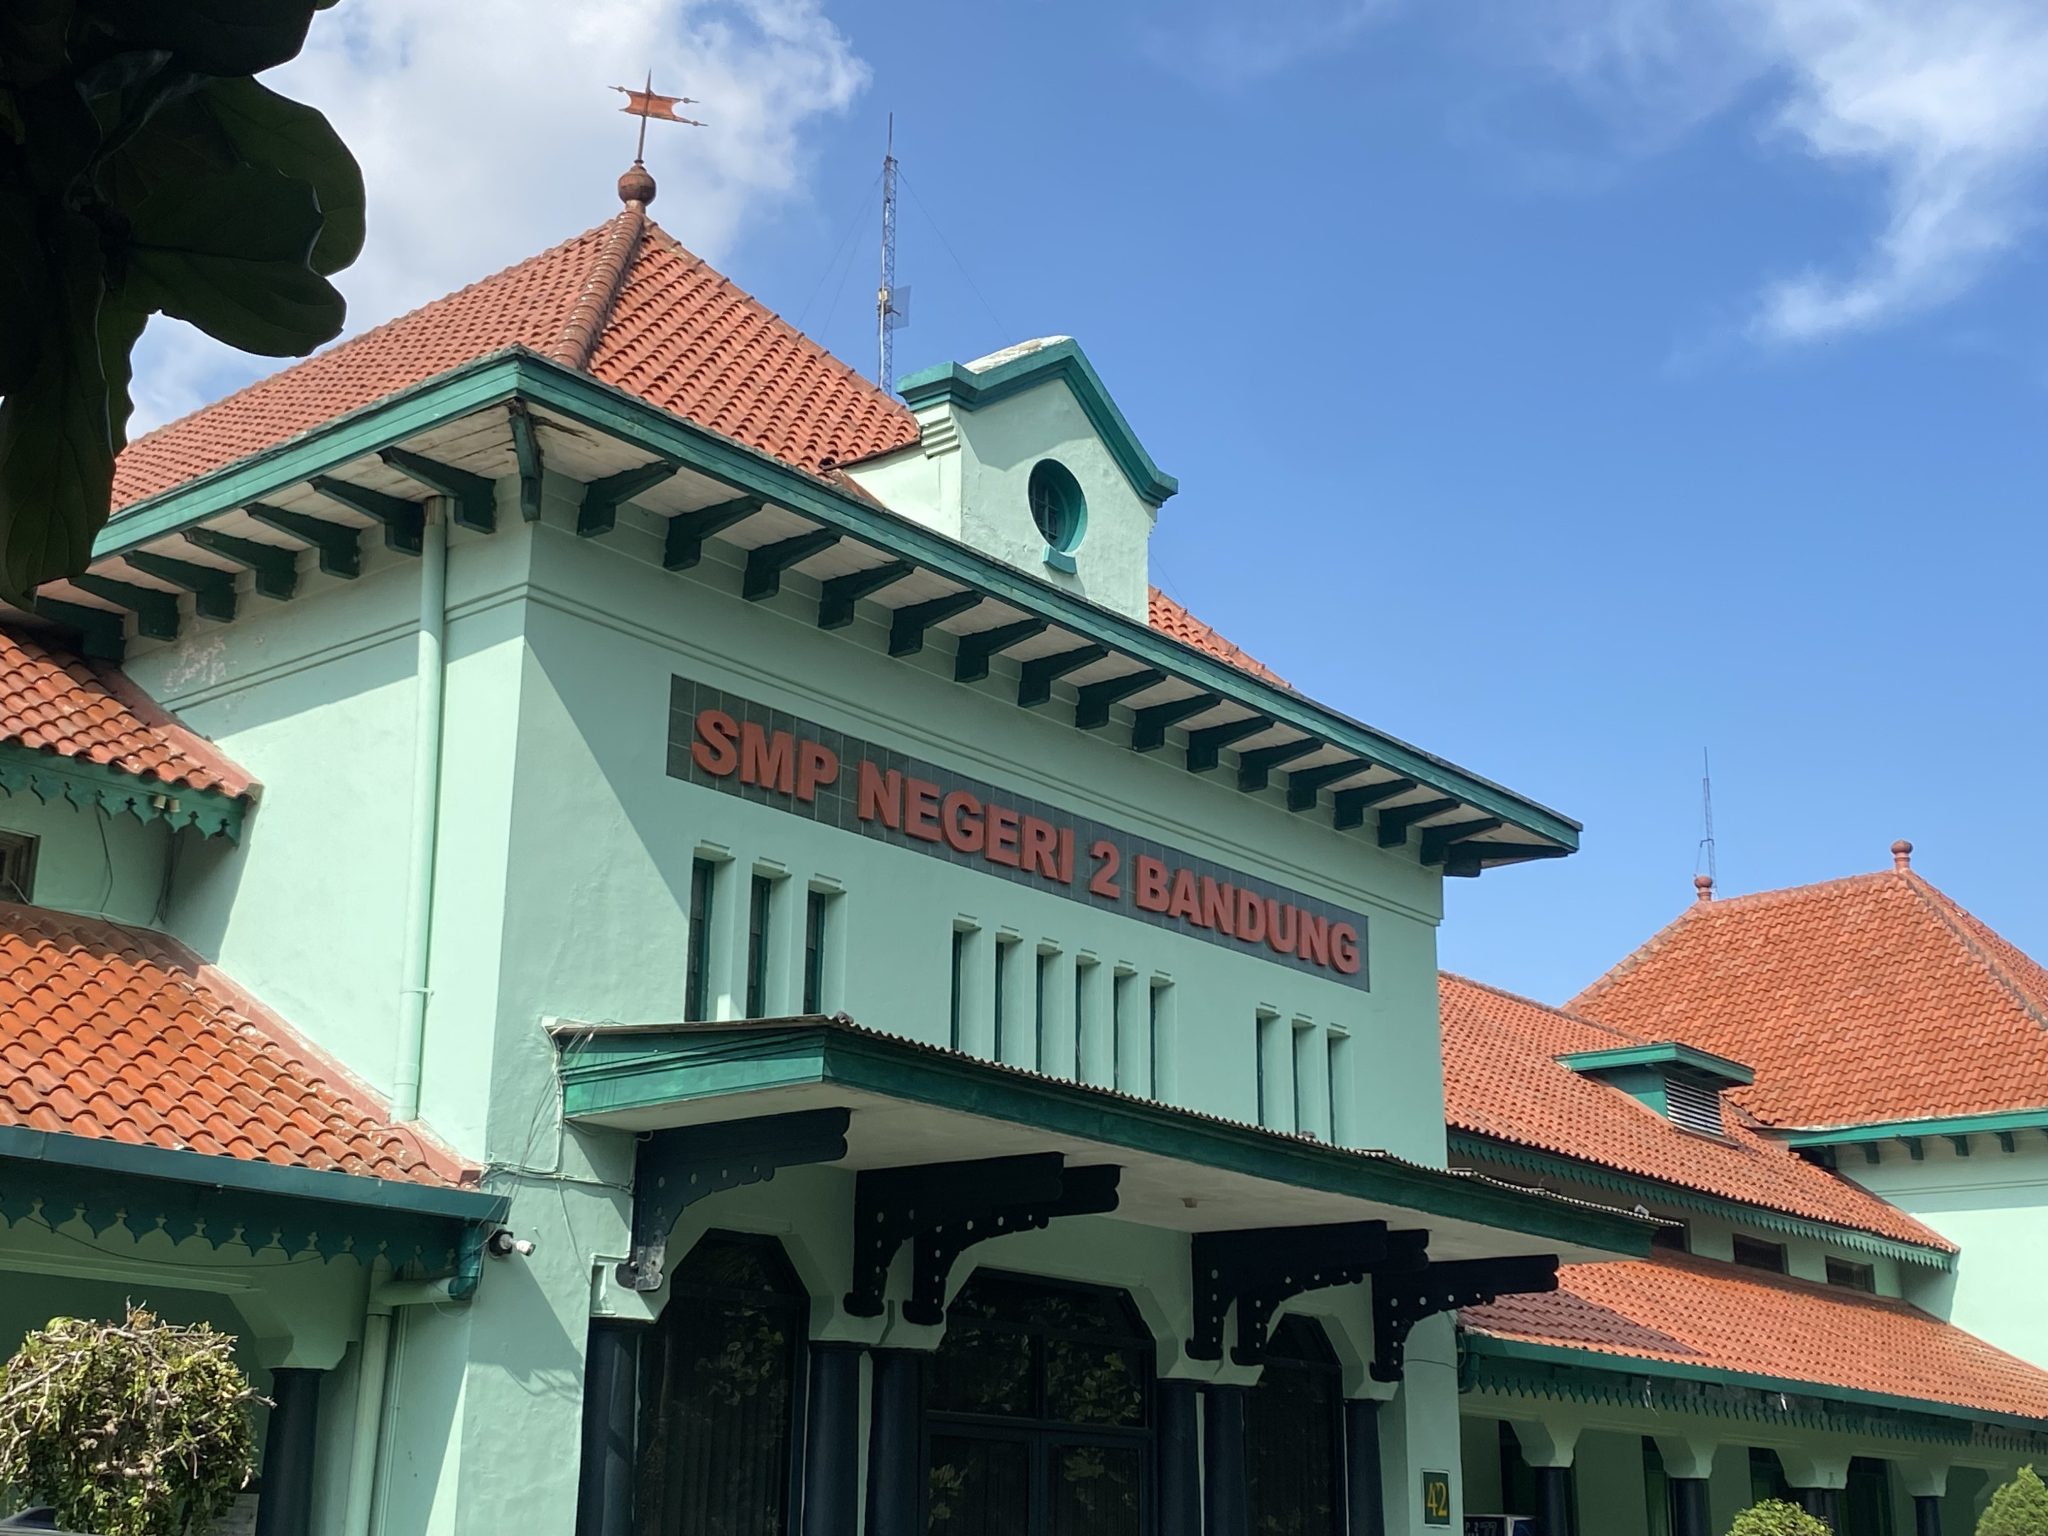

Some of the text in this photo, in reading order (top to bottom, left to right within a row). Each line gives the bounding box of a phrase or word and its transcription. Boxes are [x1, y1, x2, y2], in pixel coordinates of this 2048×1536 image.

[691, 709, 1361, 974] SMP NEGERI 2 BANDUNG
[1427, 1481, 1448, 1517] 42
